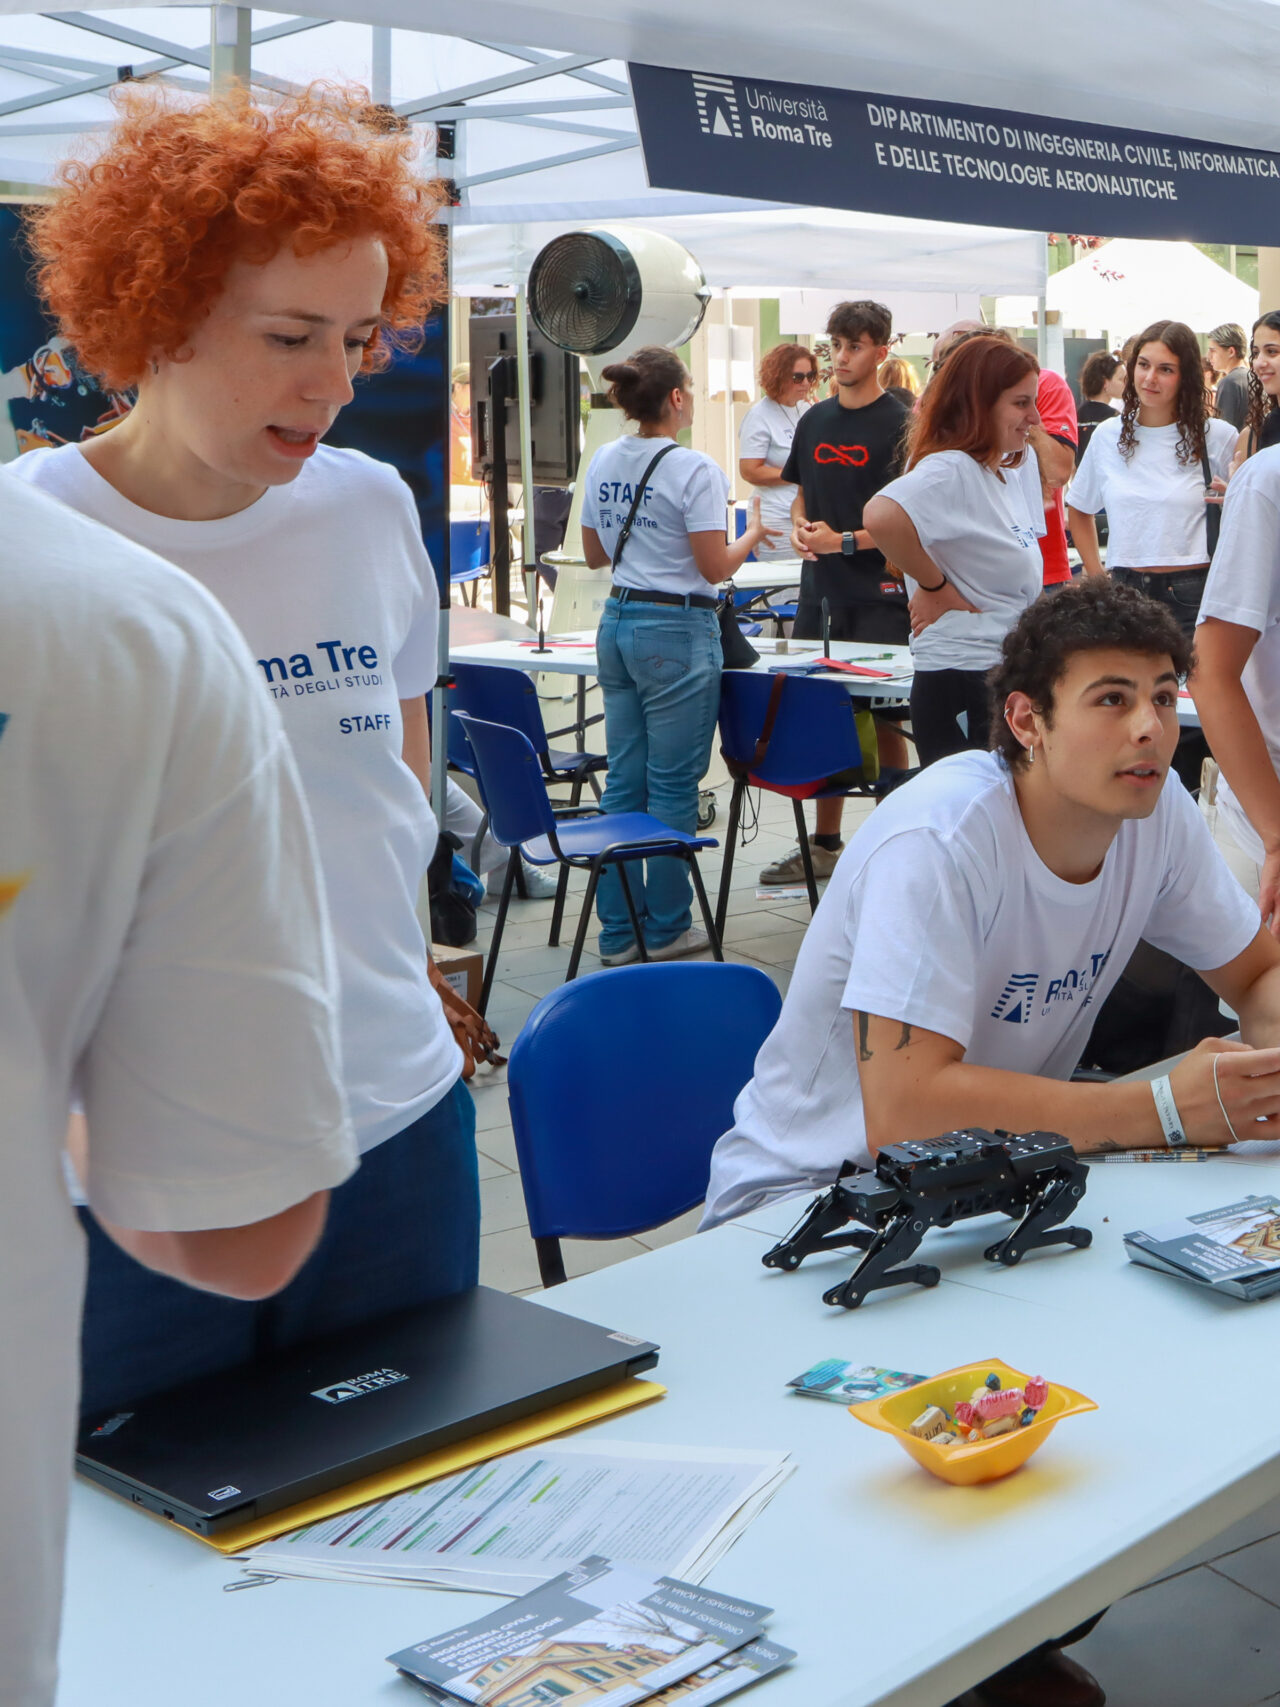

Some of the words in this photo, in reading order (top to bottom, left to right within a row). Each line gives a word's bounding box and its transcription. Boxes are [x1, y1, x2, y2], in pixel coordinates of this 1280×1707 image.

[745, 87, 828, 122] Università
[751, 115, 804, 144] Roma
[804, 124, 833, 149] Tre
[867, 103, 1001, 146] DIPARTIMENTO
[1002, 127, 1022, 150] DI
[1023, 130, 1123, 163] INGEGNERIA
[1124, 144, 1178, 171] CIVILE,
[1178, 150, 1280, 179] INFORMATICA
[874, 142, 888, 166] E
[889, 145, 942, 174] DELLE
[942, 153, 1053, 188] TECNOLOGIE
[1056, 169, 1178, 200] AERONAUTICHE
[616, 514, 641, 527] Roa
[316, 640, 378, 673] Tre
[294, 678, 340, 696] DEGLI
[344, 674, 383, 688] STUDI
[339, 714, 391, 734] STAFF
[346, 1368, 394, 1385] ROMA
[356, 1371, 406, 1389] TRE
